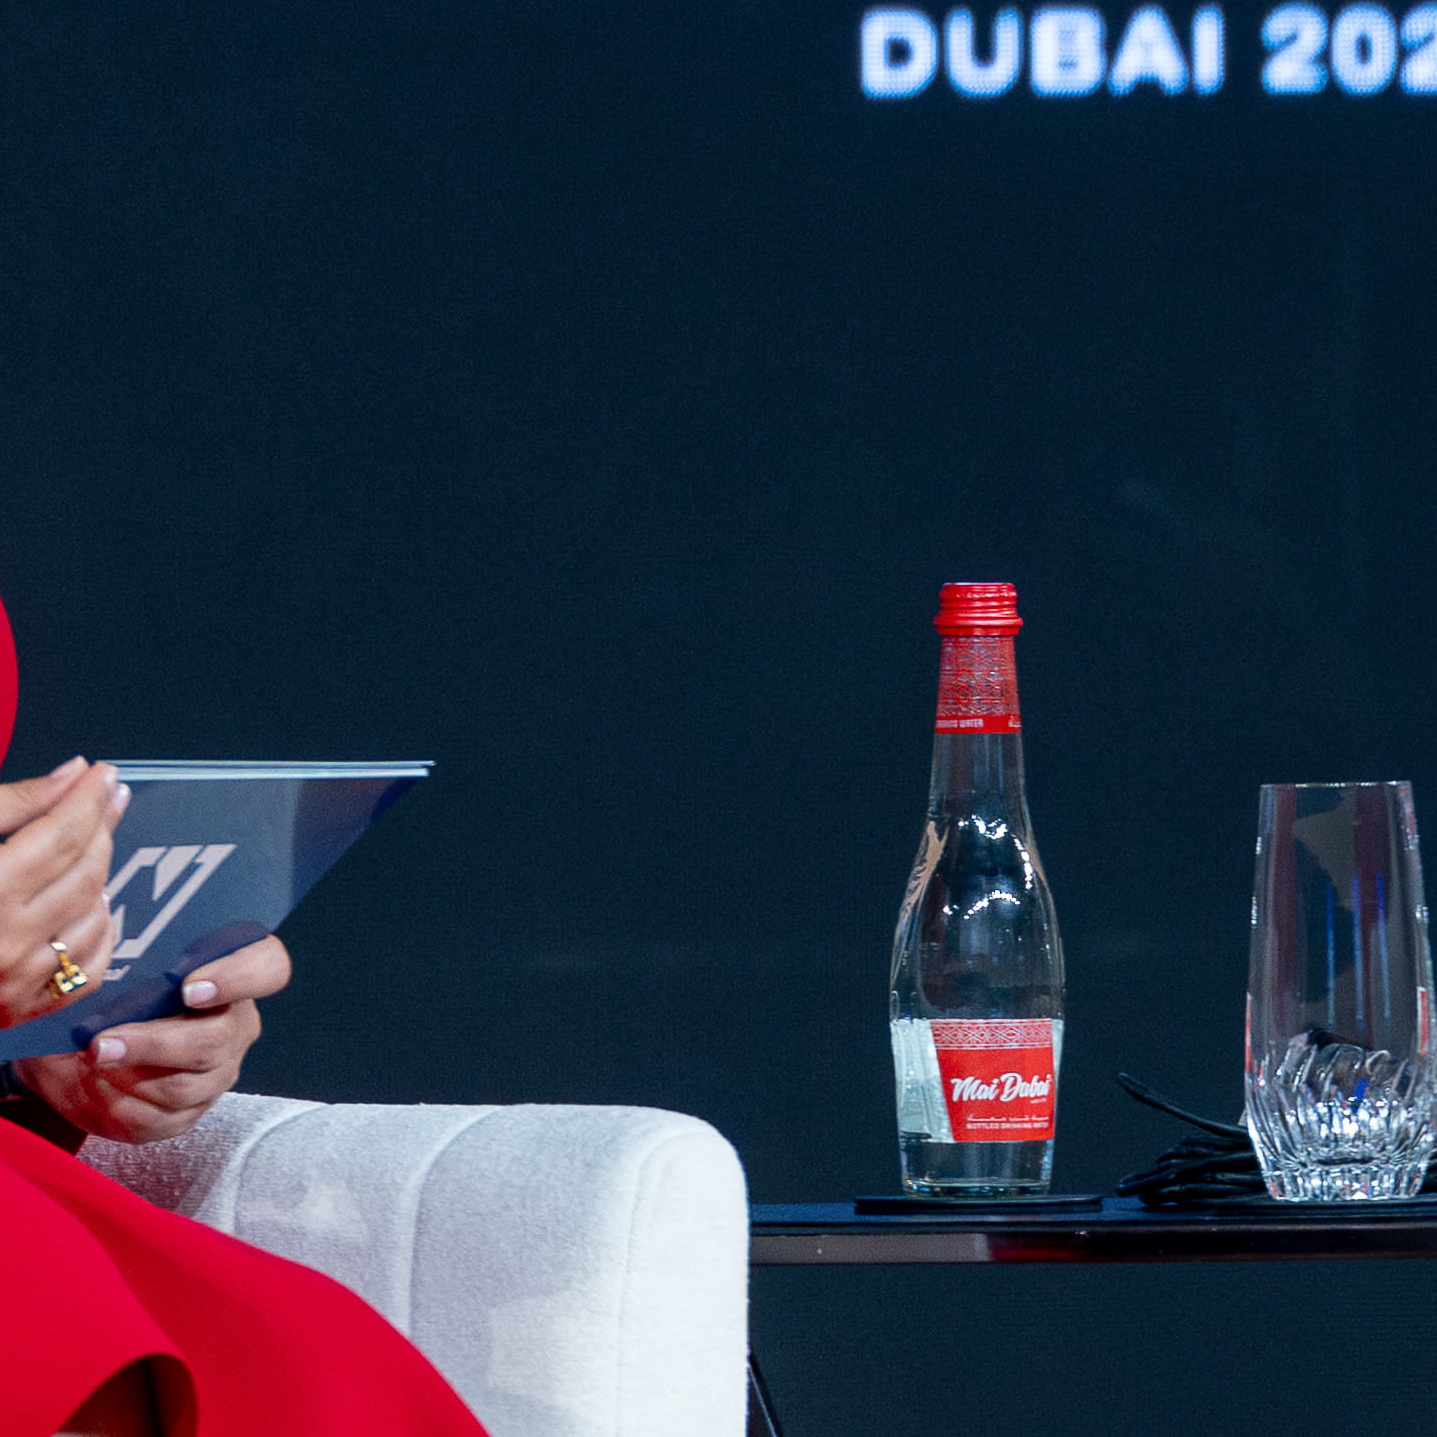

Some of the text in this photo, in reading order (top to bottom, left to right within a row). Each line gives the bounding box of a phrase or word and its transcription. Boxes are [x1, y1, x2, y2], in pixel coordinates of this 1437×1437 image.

[861, 5, 1225, 98] DUBAI
[951, 1073, 1052, 1102] Mai Dubai
